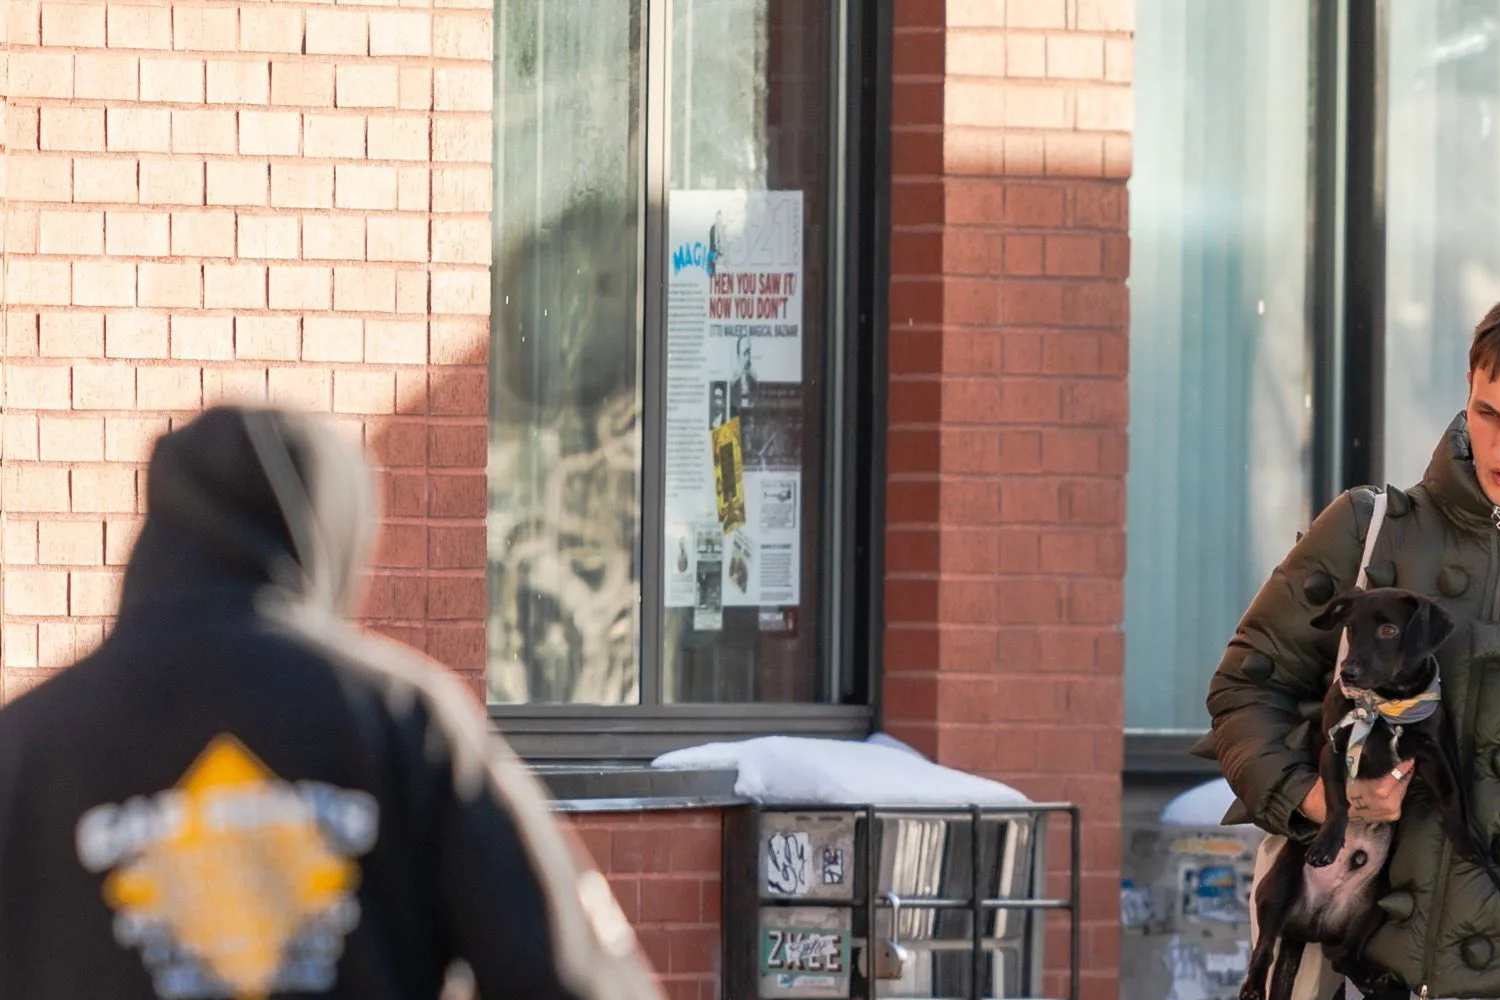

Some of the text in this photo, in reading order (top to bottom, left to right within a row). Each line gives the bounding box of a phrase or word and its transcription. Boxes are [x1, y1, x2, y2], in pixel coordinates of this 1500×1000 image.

[736, 272, 756, 294] YOU
[759, 272, 781, 294] SAW
[710, 297, 788, 319] NOW YOU DON'T
